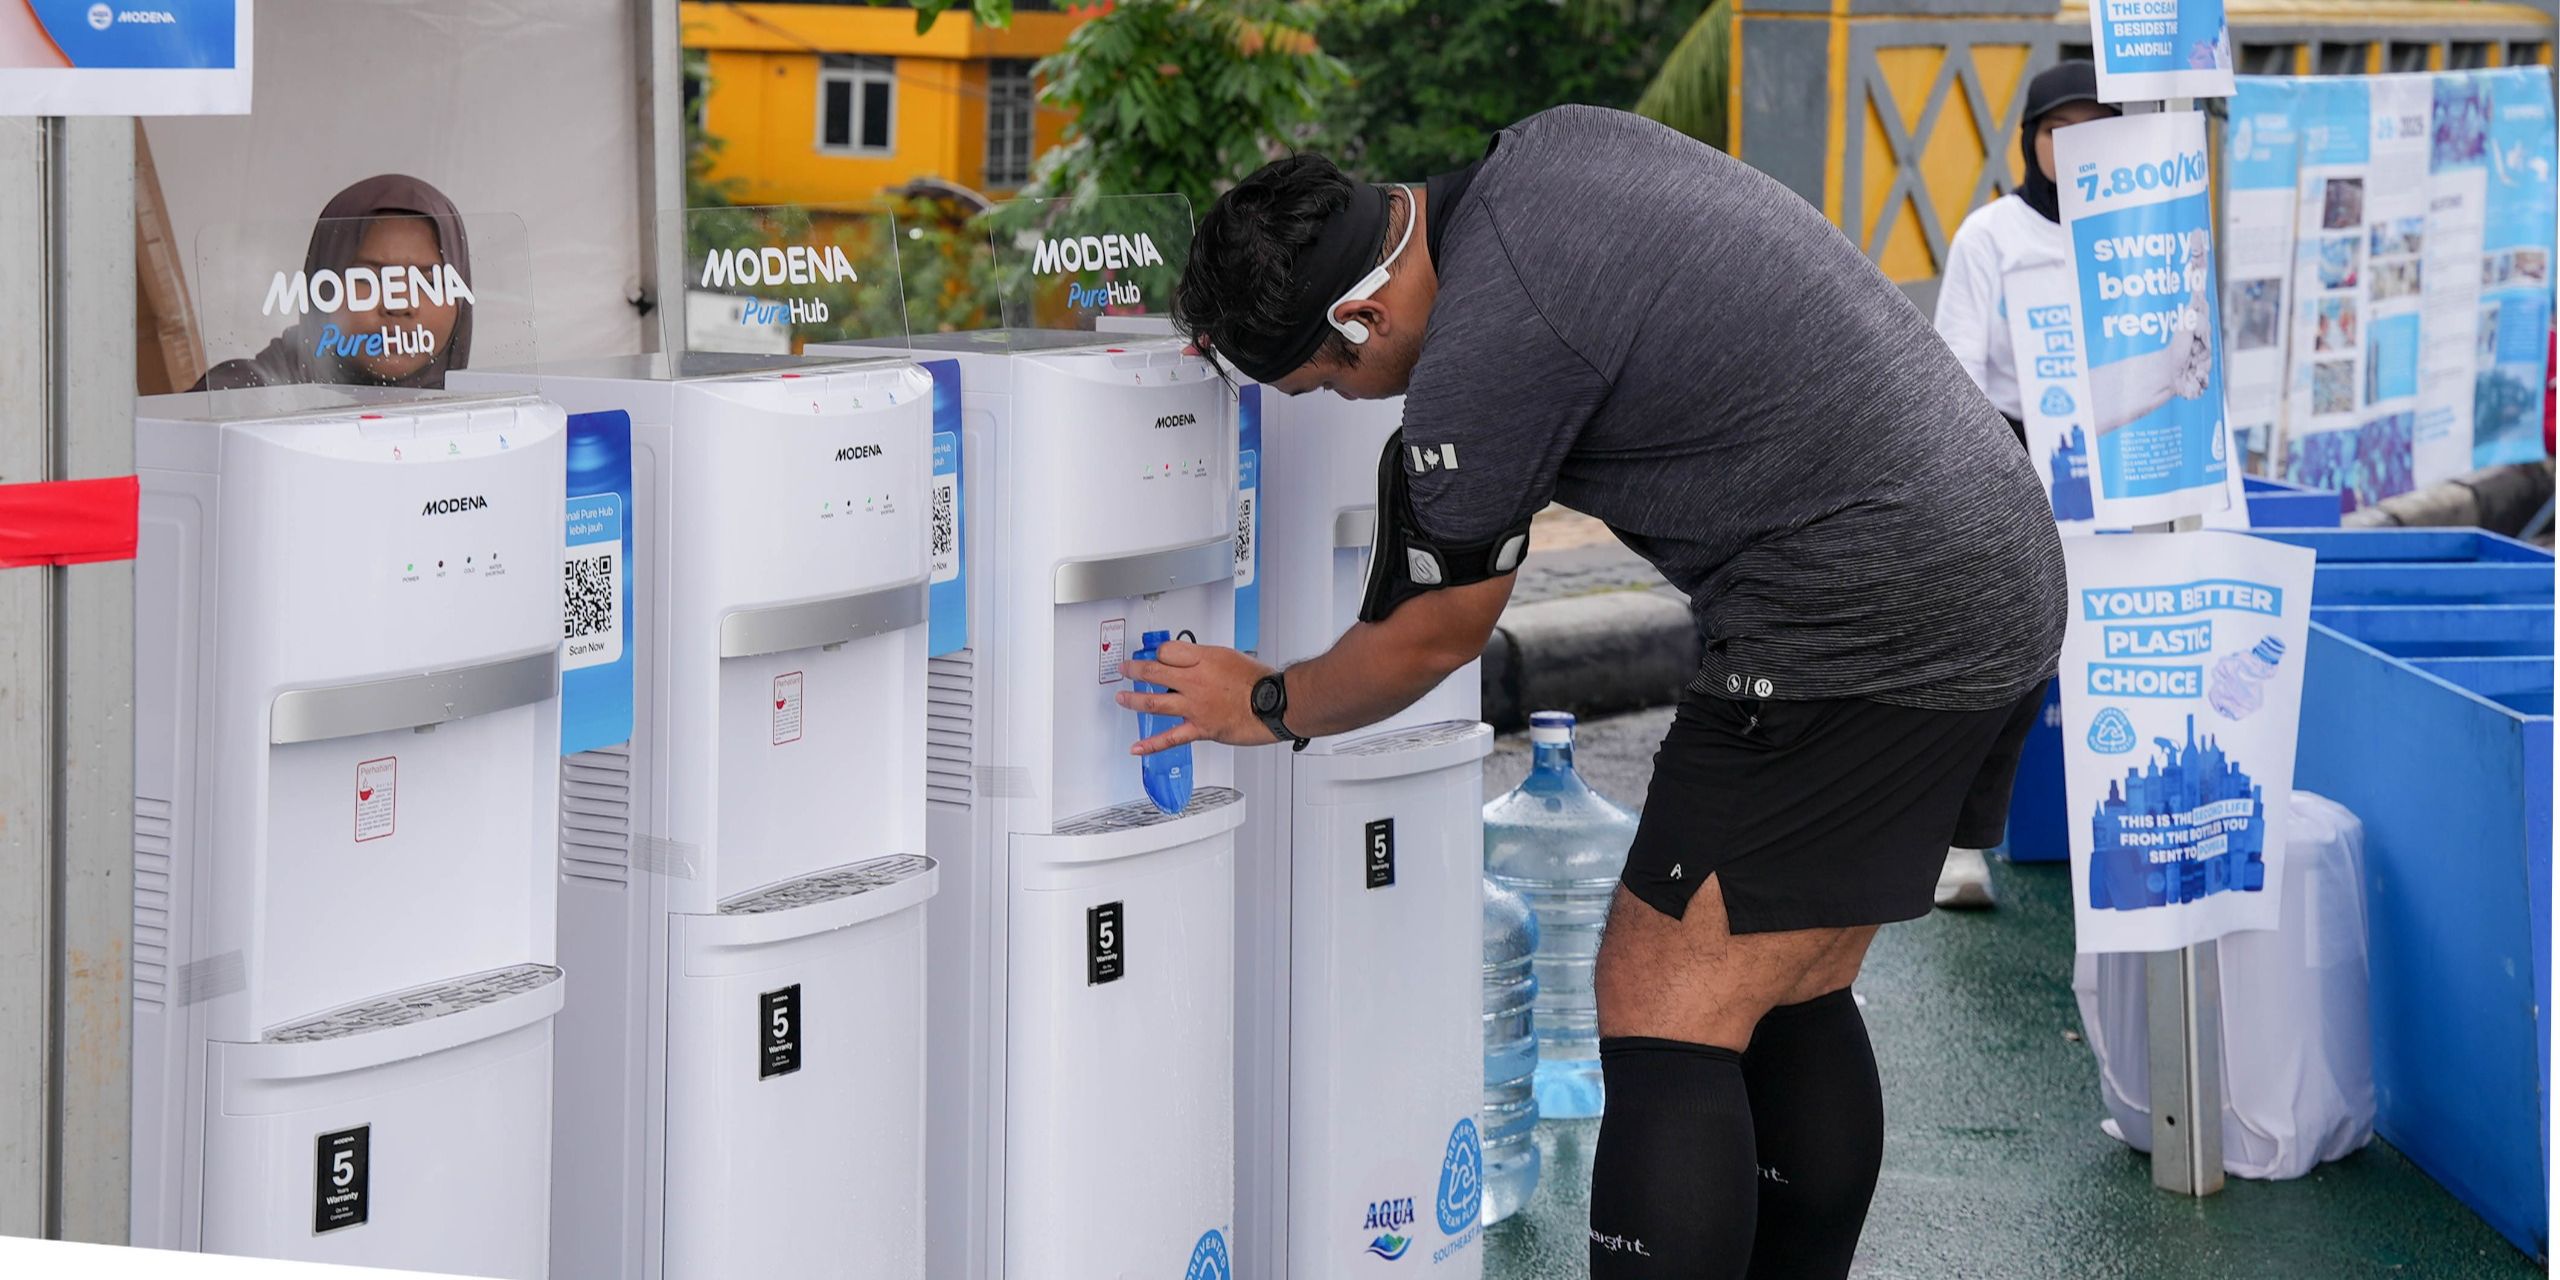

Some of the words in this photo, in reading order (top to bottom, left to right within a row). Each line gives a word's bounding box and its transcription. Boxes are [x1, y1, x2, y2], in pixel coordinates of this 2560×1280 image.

[118, 11, 176, 23] MODENA
[2112, 3, 2140, 15] THE
[2113, 22, 2164, 37] BESIDES
[2079, 162, 2097, 174] IDR
[1032, 232, 1163, 275] MODENA
[2093, 232, 2175, 265] swap
[701, 245, 858, 288] MODENA
[262, 263, 475, 316] MODENA
[2097, 266, 2180, 301] bottle
[2038, 358, 2076, 376] CH
[1155, 413, 1196, 429] MODENA
[835, 444, 882, 461] MODENA
[422, 495, 487, 516] MODENA
[581, 509, 597, 519] Pure
[598, 506, 614, 517] Hub
[569, 524, 587, 536] lebih
[2087, 591, 2175, 616] YOUR
[2180, 584, 2273, 612] BETTER
[569, 644, 587, 656] Scan
[588, 641, 605, 653] Now
[2108, 626, 2210, 654] PLASTIC
[2091, 668, 2197, 695] CHOICE
[2118, 815, 2154, 828] THIS
[2157, 814, 2170, 827] IS
[2172, 812, 2192, 826] THE
[2225, 802, 2249, 813] LIFE
[2120, 832, 2164, 846] FROM
[2167, 831, 2189, 844] THE
[2223, 818, 2248, 831] YOU
[1374, 833, 1387, 858] 5
[2150, 849, 2182, 864] SENT
[2184, 847, 2197, 859] TO
[1099, 920, 1114, 949] 5
[772, 1006, 789, 1038] 5
[768, 1042, 792, 1054] Warranty
[332, 1149, 354, 1186] 5
[326, 1191, 359, 1205] Warranty
[1363, 1196, 1415, 1231] AQUA
[1440, 1199, 1460, 1227] OCEAN
[1433, 1227, 1476, 1265] SOUTHEAST
